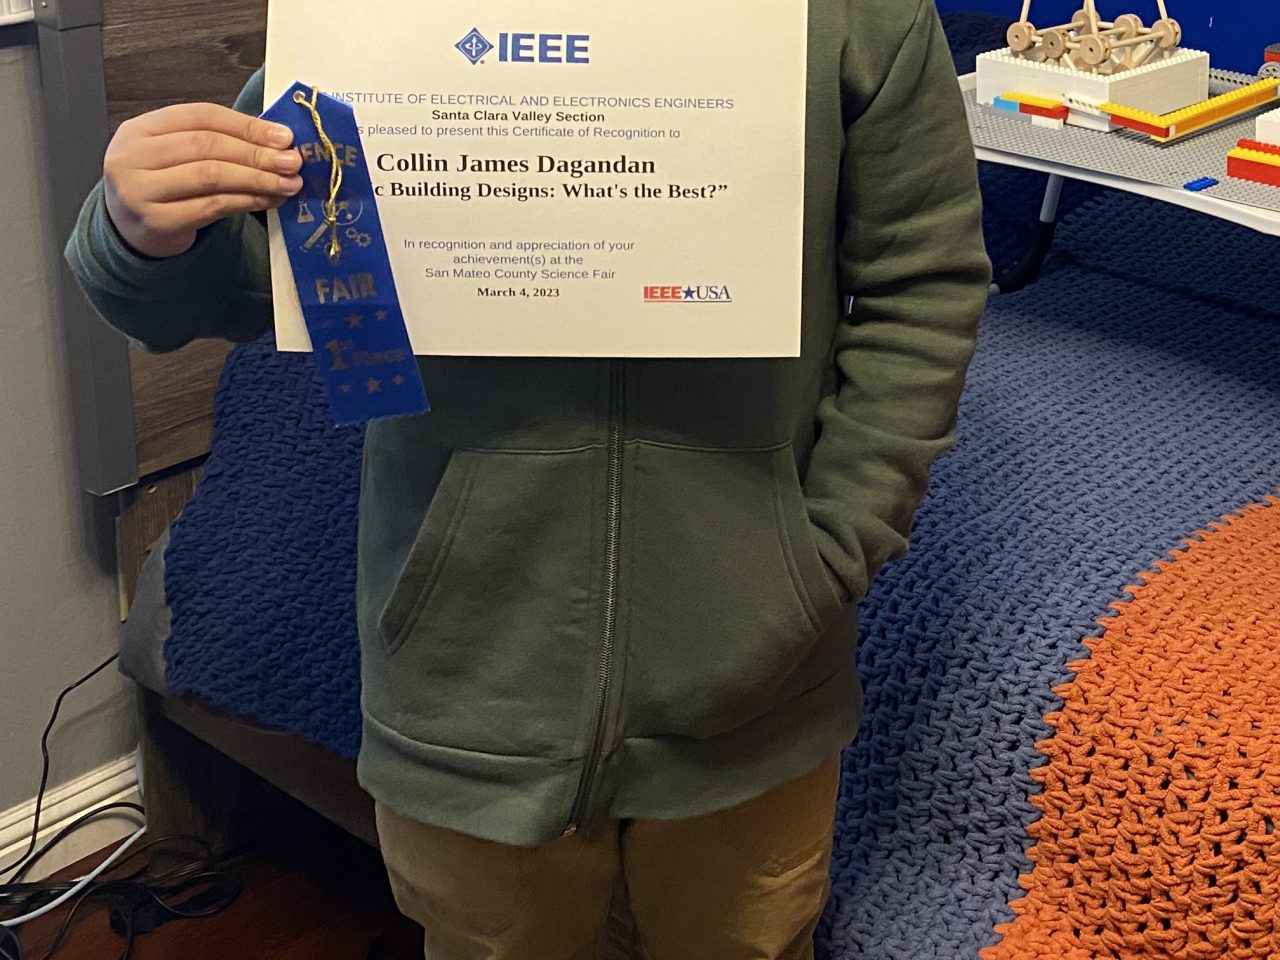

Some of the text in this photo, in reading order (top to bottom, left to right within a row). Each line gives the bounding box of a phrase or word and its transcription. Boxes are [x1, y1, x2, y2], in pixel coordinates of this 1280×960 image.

[498, 32, 590, 64] IEEE
[407, 93, 427, 104] OF
[430, 94, 515, 106] ELECTRICAL
[520, 95, 549, 107] AND
[553, 96, 650, 108] ELECTRONICS
[654, 98, 734, 109] ENGINEERS
[431, 109, 605, 123] Santa Clara Valley Section
[368, 124, 417, 138] pleased
[421, 126, 433, 136] to
[436, 125, 483, 138] present
[487, 125, 509, 136] this
[512, 125, 574, 137] Certificate
[578, 126, 590, 137] of
[593, 127, 665, 140] Recognition
[669, 128, 681, 139] to
[296, 142, 358, 168] ENCE
[376, 153, 656, 179] Collin James Dagandan
[390, 182, 472, 201] Building
[477, 183, 555, 202] Designs:
[562, 183, 628, 198] What's
[634, 183, 662, 198] the
[404, 239, 635, 252] In recognition and appreciation of your
[453, 254, 584, 266] achievement(s) at the
[425, 268, 616, 281] San Mateo County Science Fair
[315, 272, 378, 305] FAIR
[477, 287, 560, 299] March 4, 2023
[643, 285, 731, 300] IEEE USA
